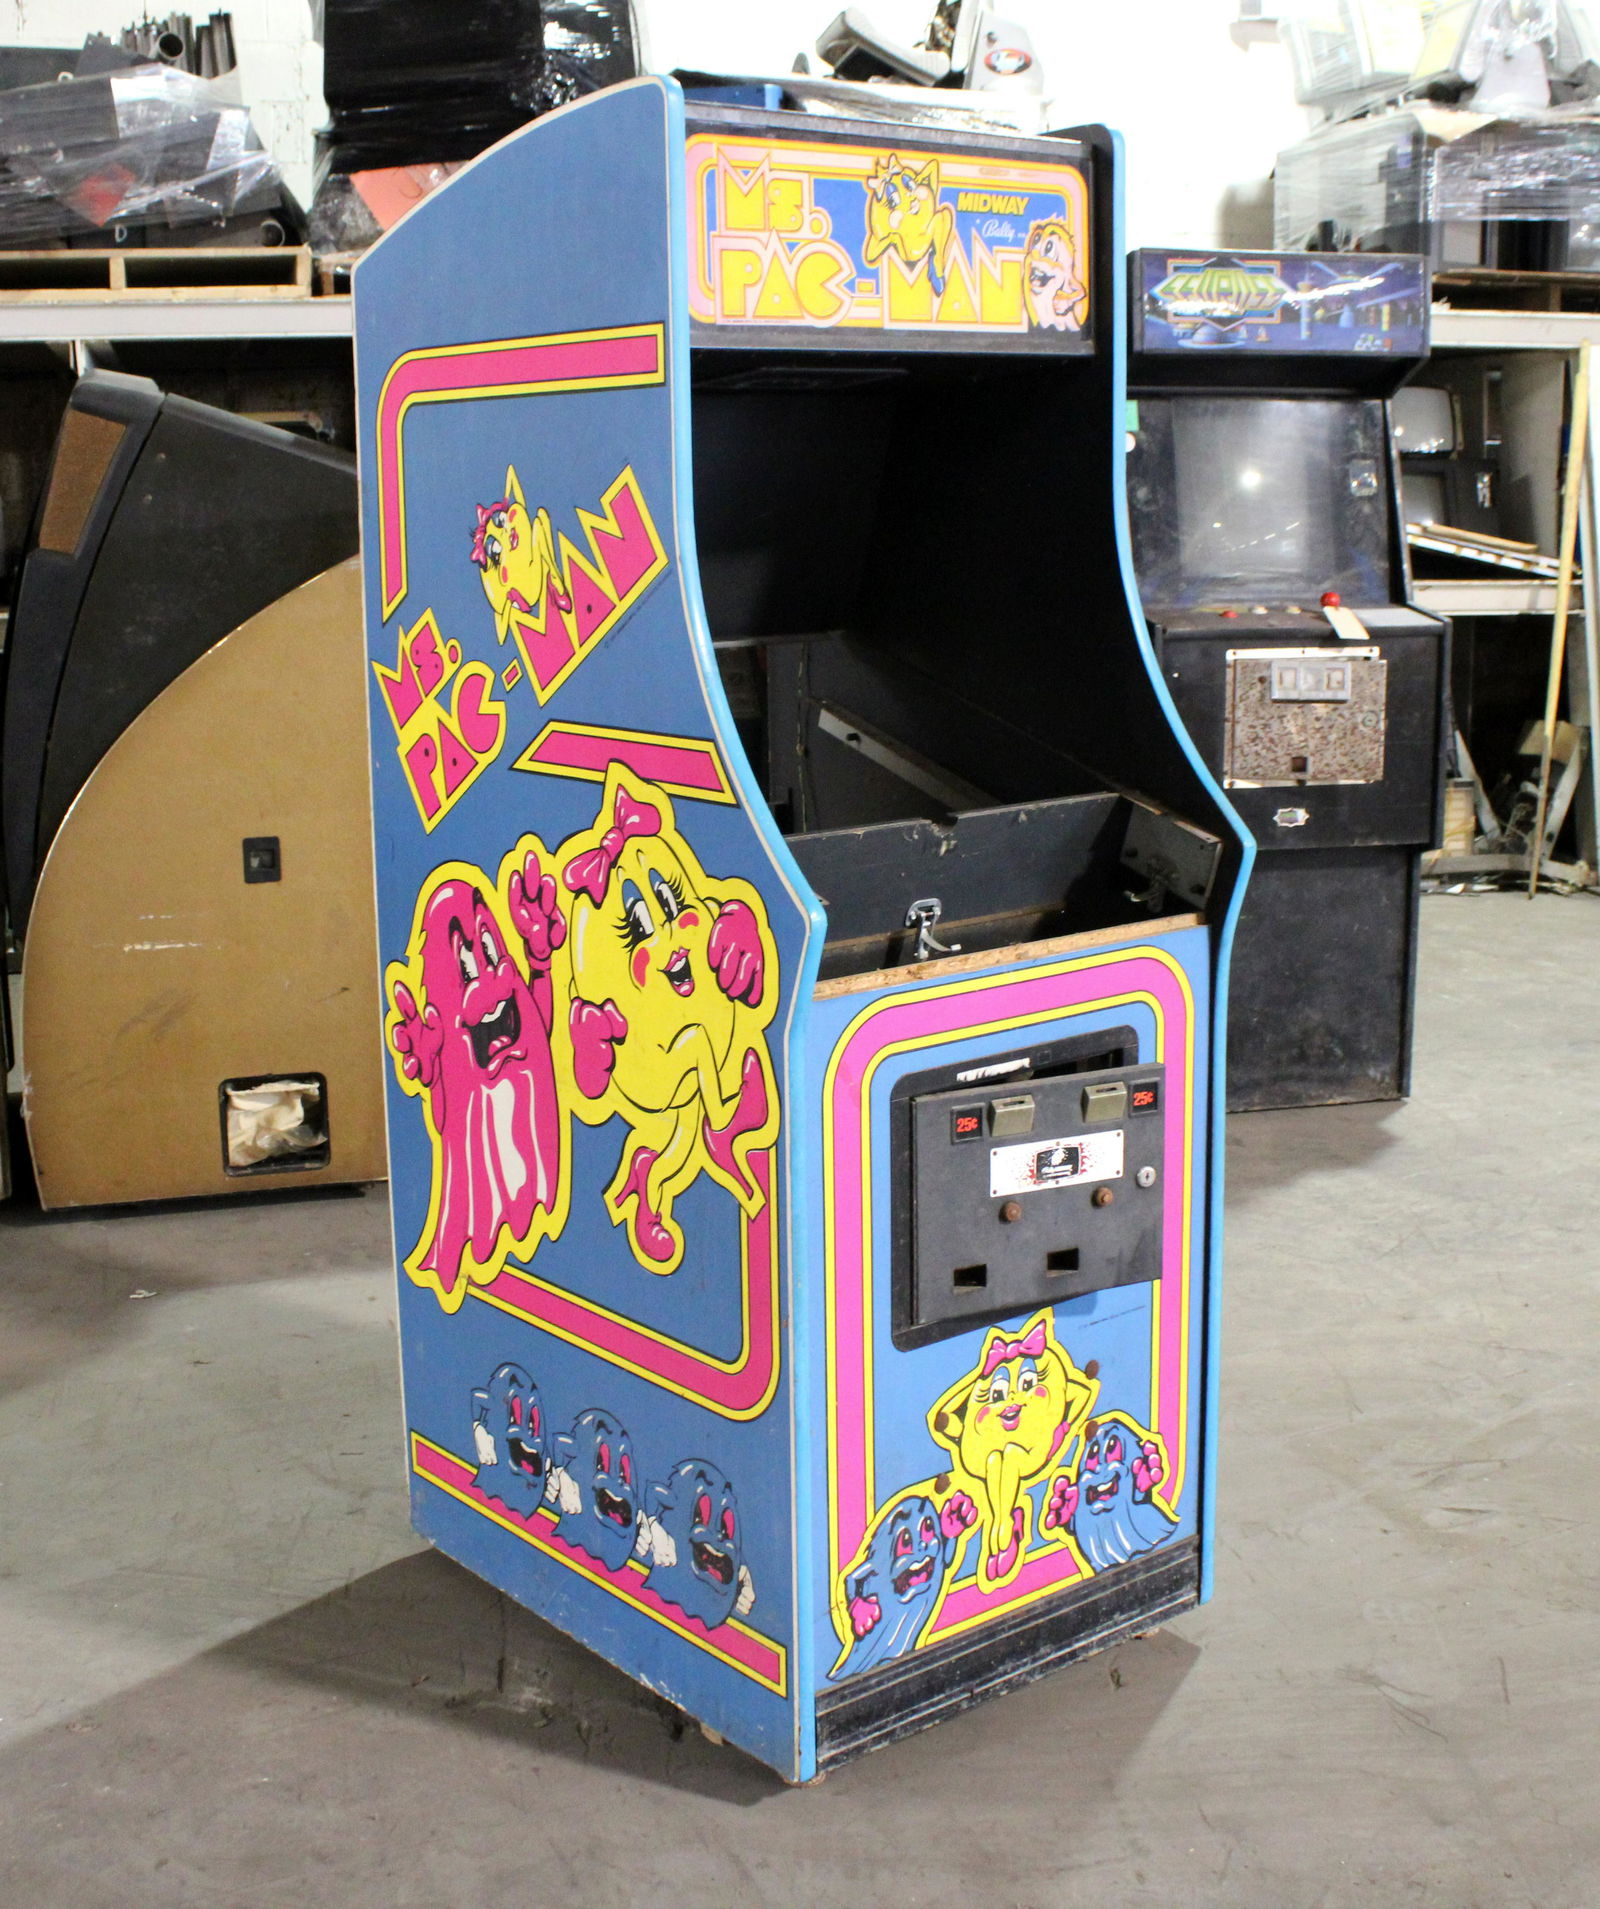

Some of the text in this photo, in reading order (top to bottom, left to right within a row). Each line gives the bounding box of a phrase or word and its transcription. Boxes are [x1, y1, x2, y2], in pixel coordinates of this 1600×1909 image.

[716, 144, 832, 240] MS.
[957, 191, 1031, 216] MIDWAY
[713, 228, 1029, 333] PAC-MAN
[370, 606, 463, 737] MS.
